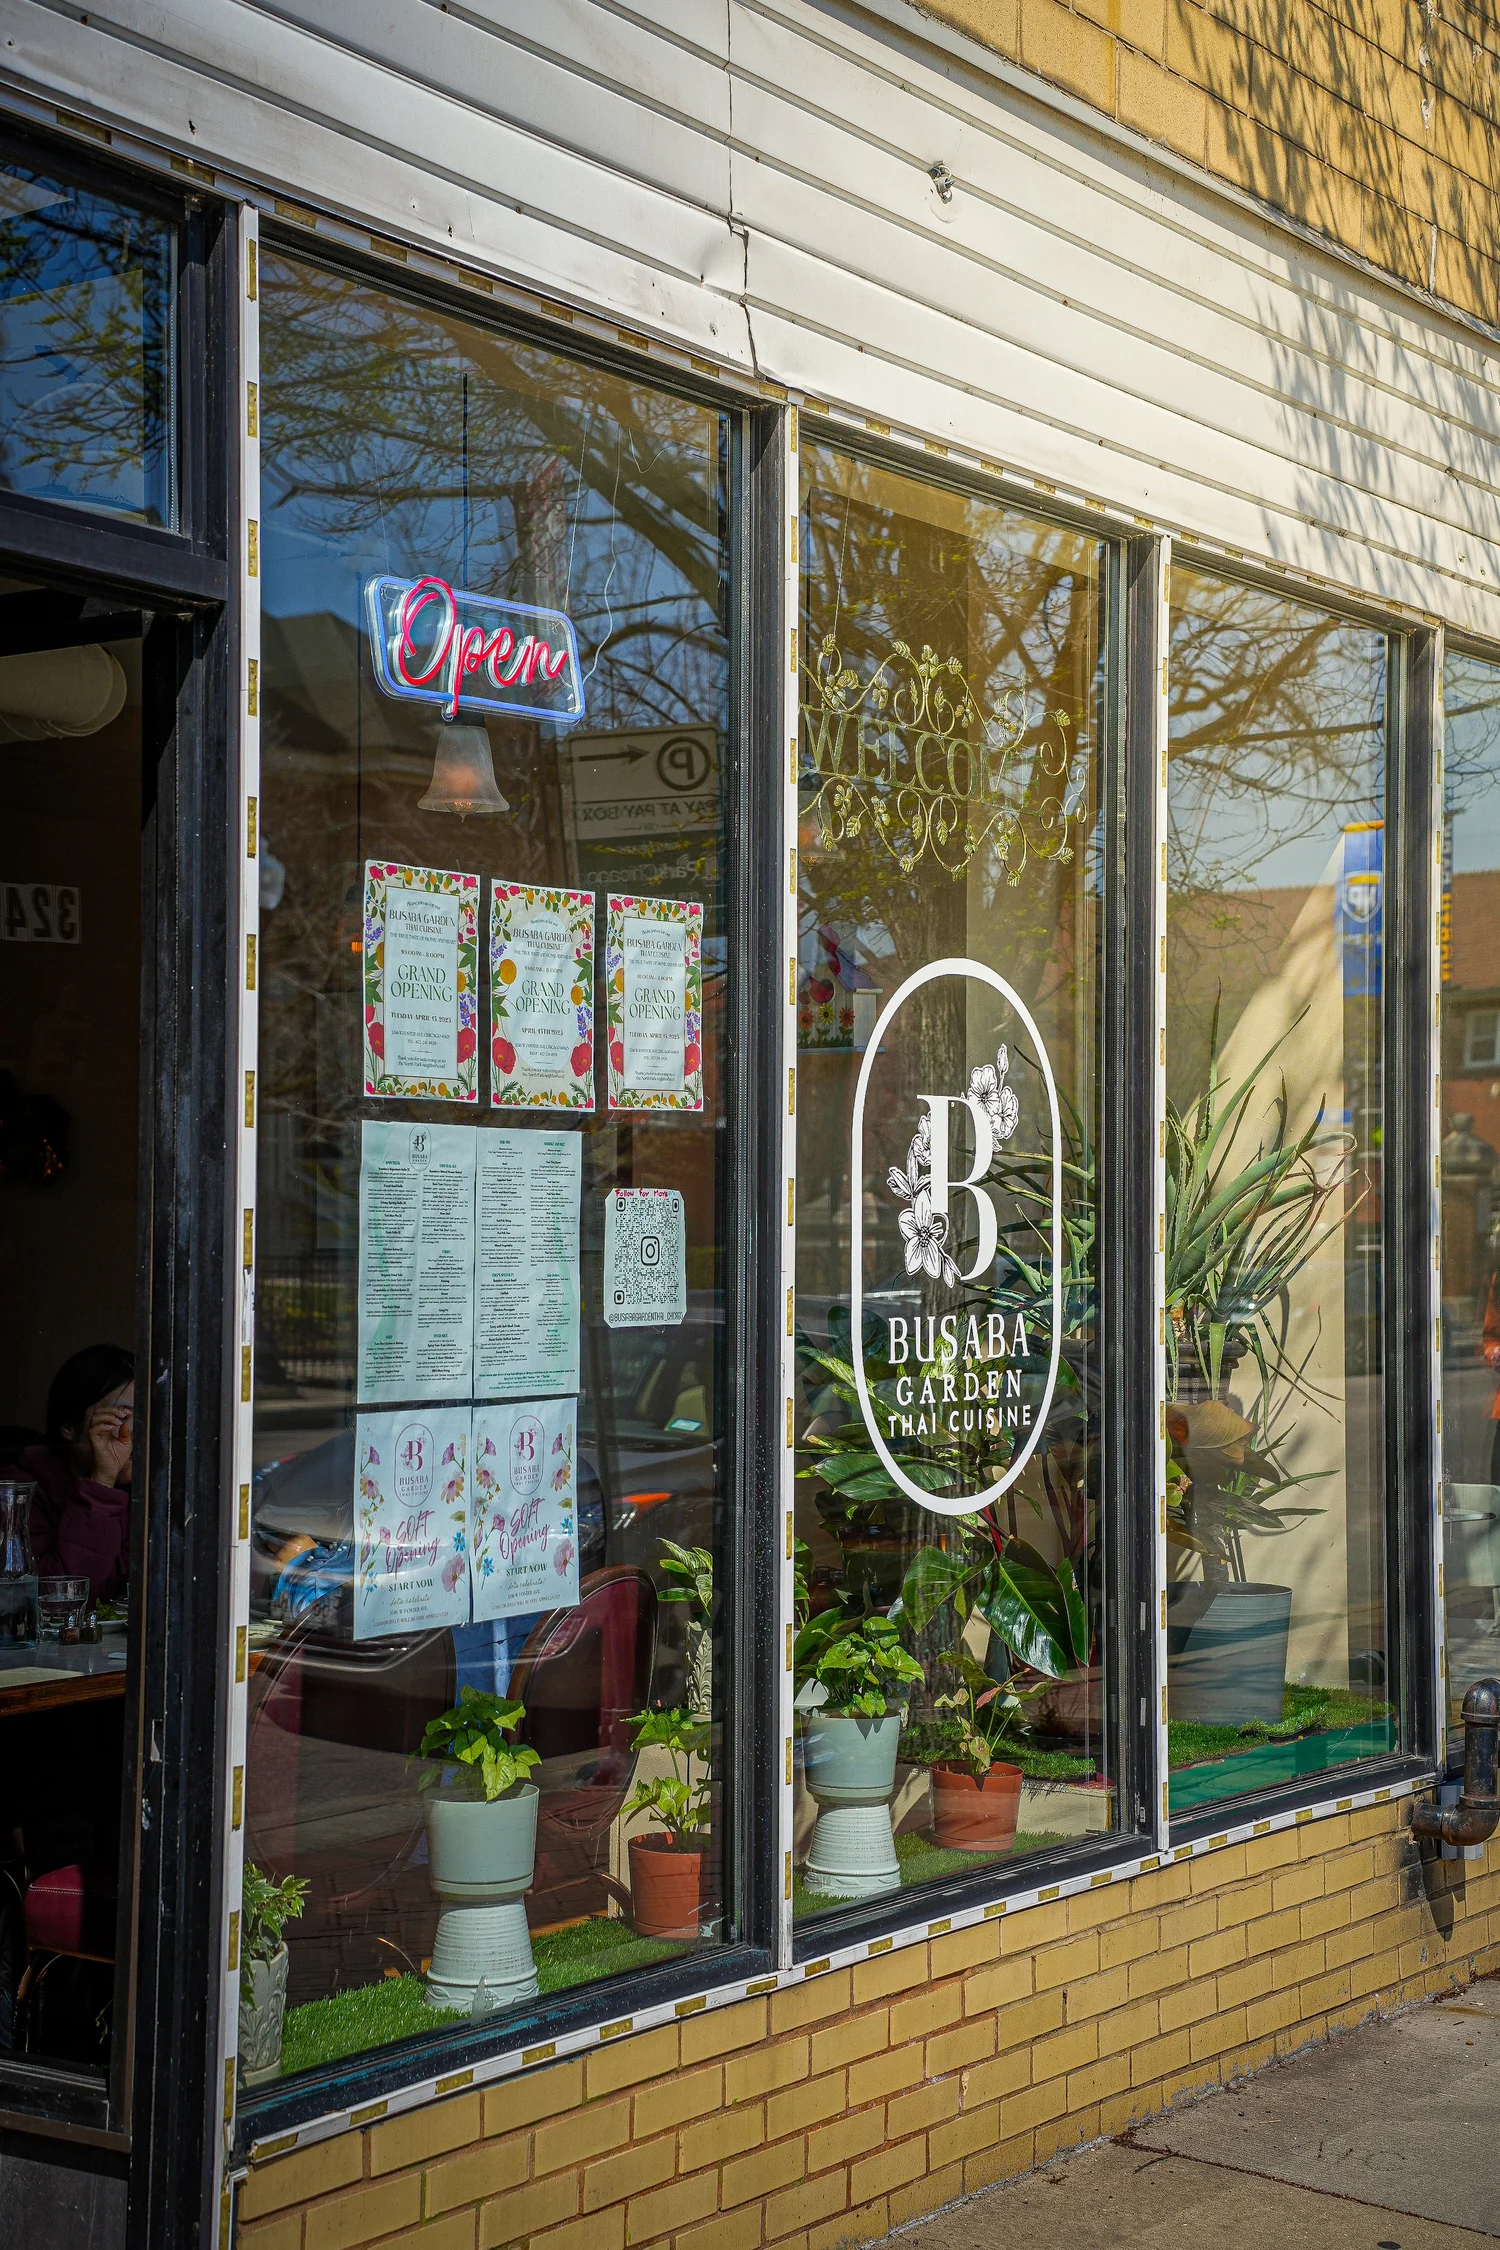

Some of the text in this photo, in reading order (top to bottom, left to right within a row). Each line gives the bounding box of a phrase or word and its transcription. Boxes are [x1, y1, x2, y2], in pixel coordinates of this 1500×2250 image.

[396, 576, 569, 717] Open
[799, 703, 1046, 816] WELCOME
[389, 909, 455, 927] BUSABA GARDEN
[405, 923, 443, 934] THAI CUISINE
[513, 928, 573, 943] BUSABA GARDEN
[541, 942, 562, 950] CUISINE
[627, 938, 682, 951] BUSABA GARDEN
[398, 964, 446, 984] GRAND
[390, 981, 453, 1002] OPENING
[522, 980, 564, 998] GRAND
[635, 987, 675, 1004] GRAND
[516, 997, 570, 1015] OPENING
[629, 1003, 680, 1020] OPENING
[521, 1027, 536, 1035] APRIL
[615, 1188, 634, 1197] Follow
[917, 1094, 998, 1282] B
[888, 1313, 1030, 1364] BUSABA
[896, 1369, 1022, 1406] GARDEN
[888, 1405, 1031, 1437] THAI CUISINE
[519, 1431, 534, 1461] B
[407, 1440, 423, 1471] B
[514, 1464, 540, 1475] BUSABA
[515, 1473, 538, 1481] GARDEN
[400, 1475, 428, 1485] BUSABA
[401, 1484, 427, 1492] GARDEN
[500, 1524, 550, 1565] Opening
[385, 1537, 440, 1579] Opening
[506, 1563, 547, 1576] START NOW
[389, 1579, 434, 1592] START NOW
